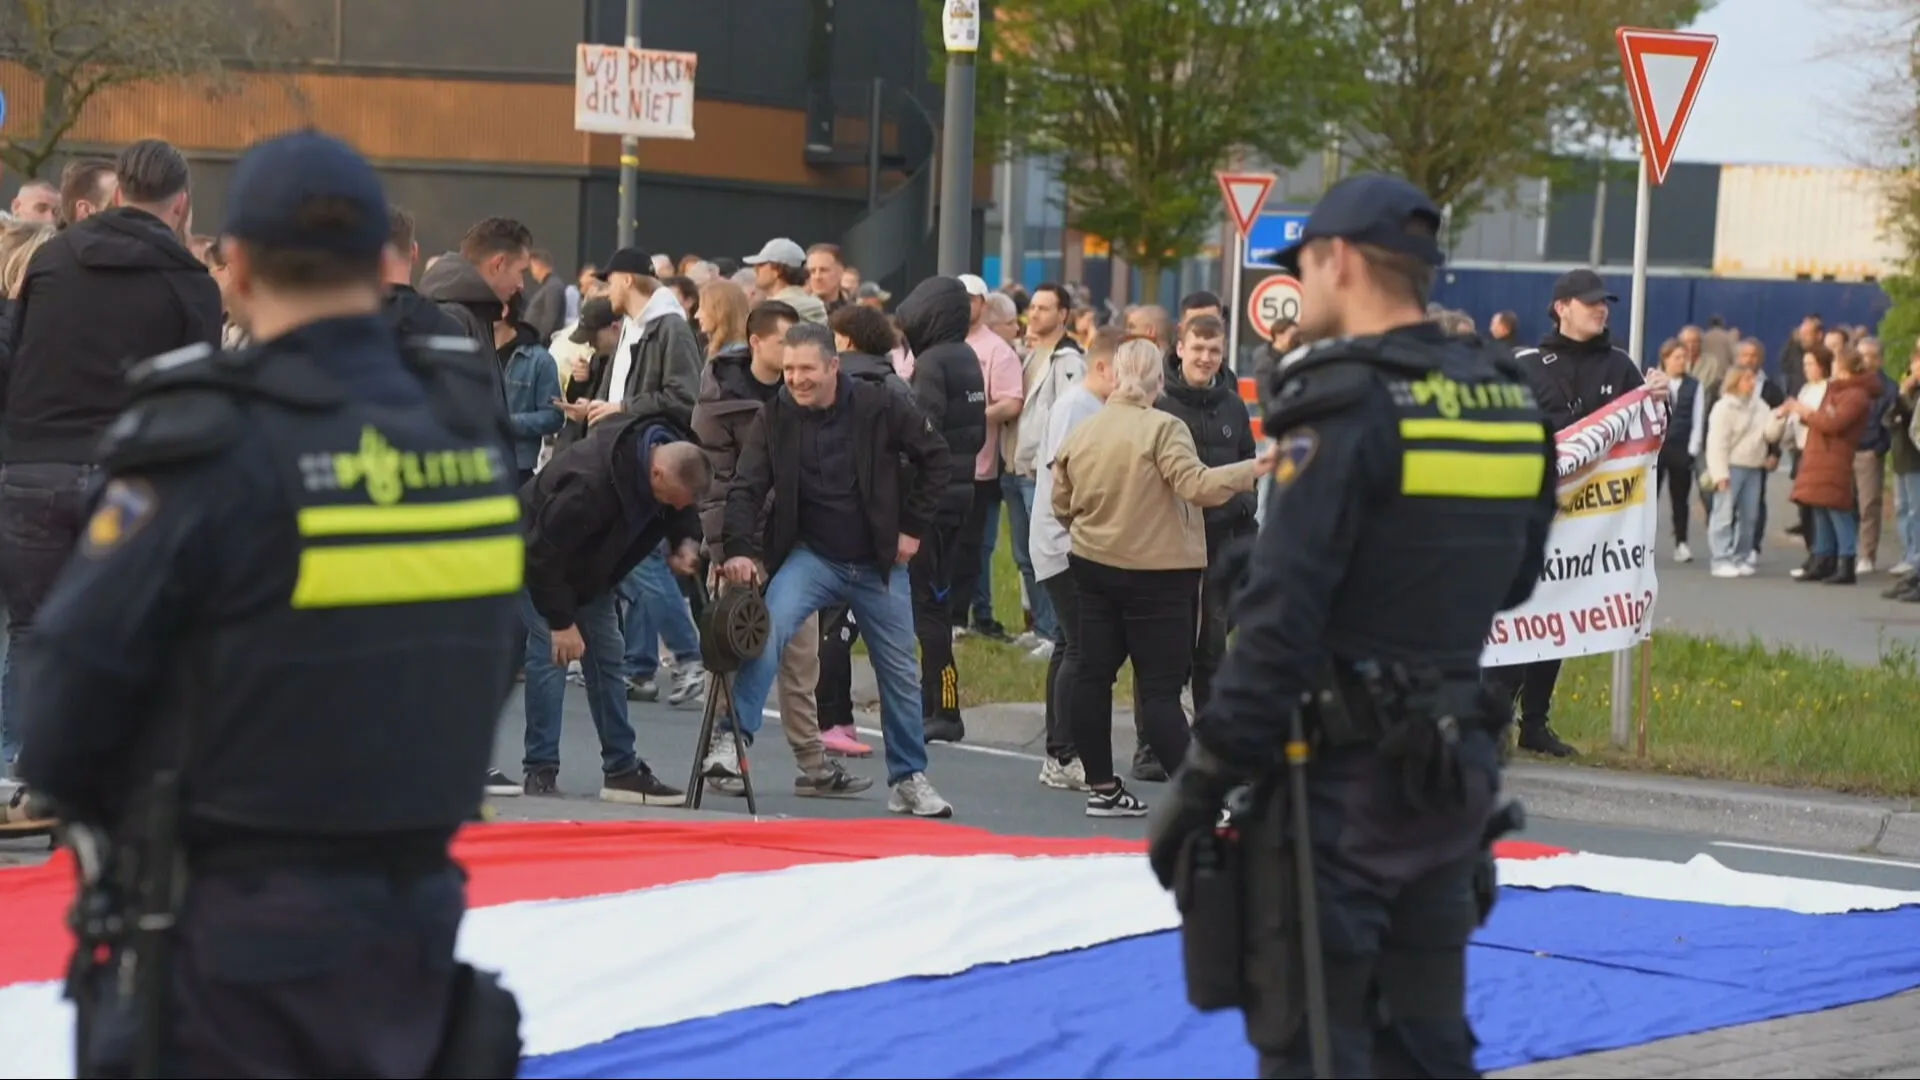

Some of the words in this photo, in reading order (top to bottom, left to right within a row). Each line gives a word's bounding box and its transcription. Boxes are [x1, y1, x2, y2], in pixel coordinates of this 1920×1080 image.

[585, 79, 621, 115] dit
[1262, 297, 1298, 320] 50
[1540, 544, 1596, 582] kind
[1514, 611, 1565, 646] nog
